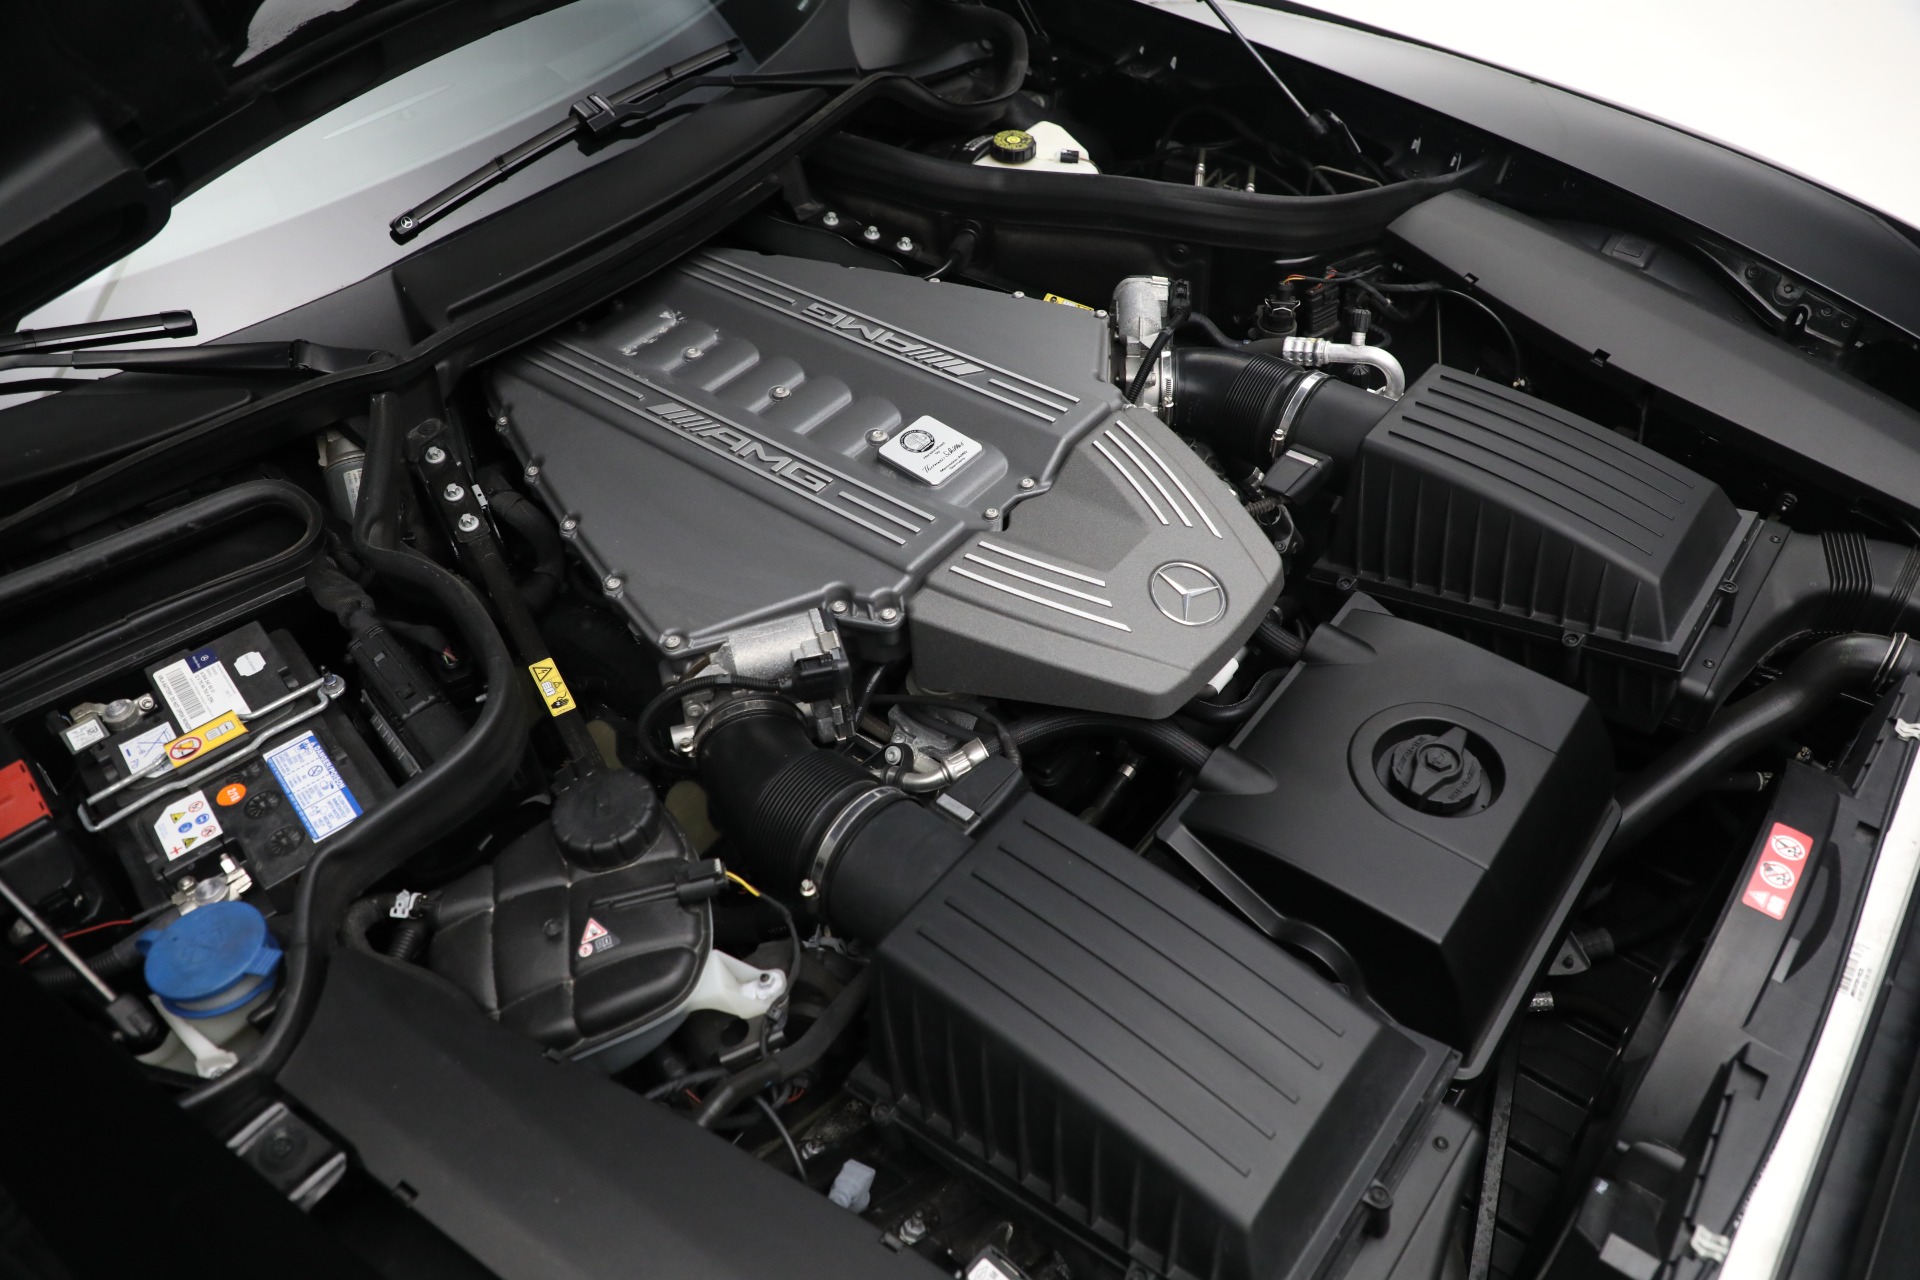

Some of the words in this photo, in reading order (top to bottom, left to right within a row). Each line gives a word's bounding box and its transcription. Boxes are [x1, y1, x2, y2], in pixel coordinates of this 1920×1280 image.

[802, 302, 927, 353] AMG
[697, 427, 833, 493] AMG
[313, 744, 345, 789] DANGER/POISON
